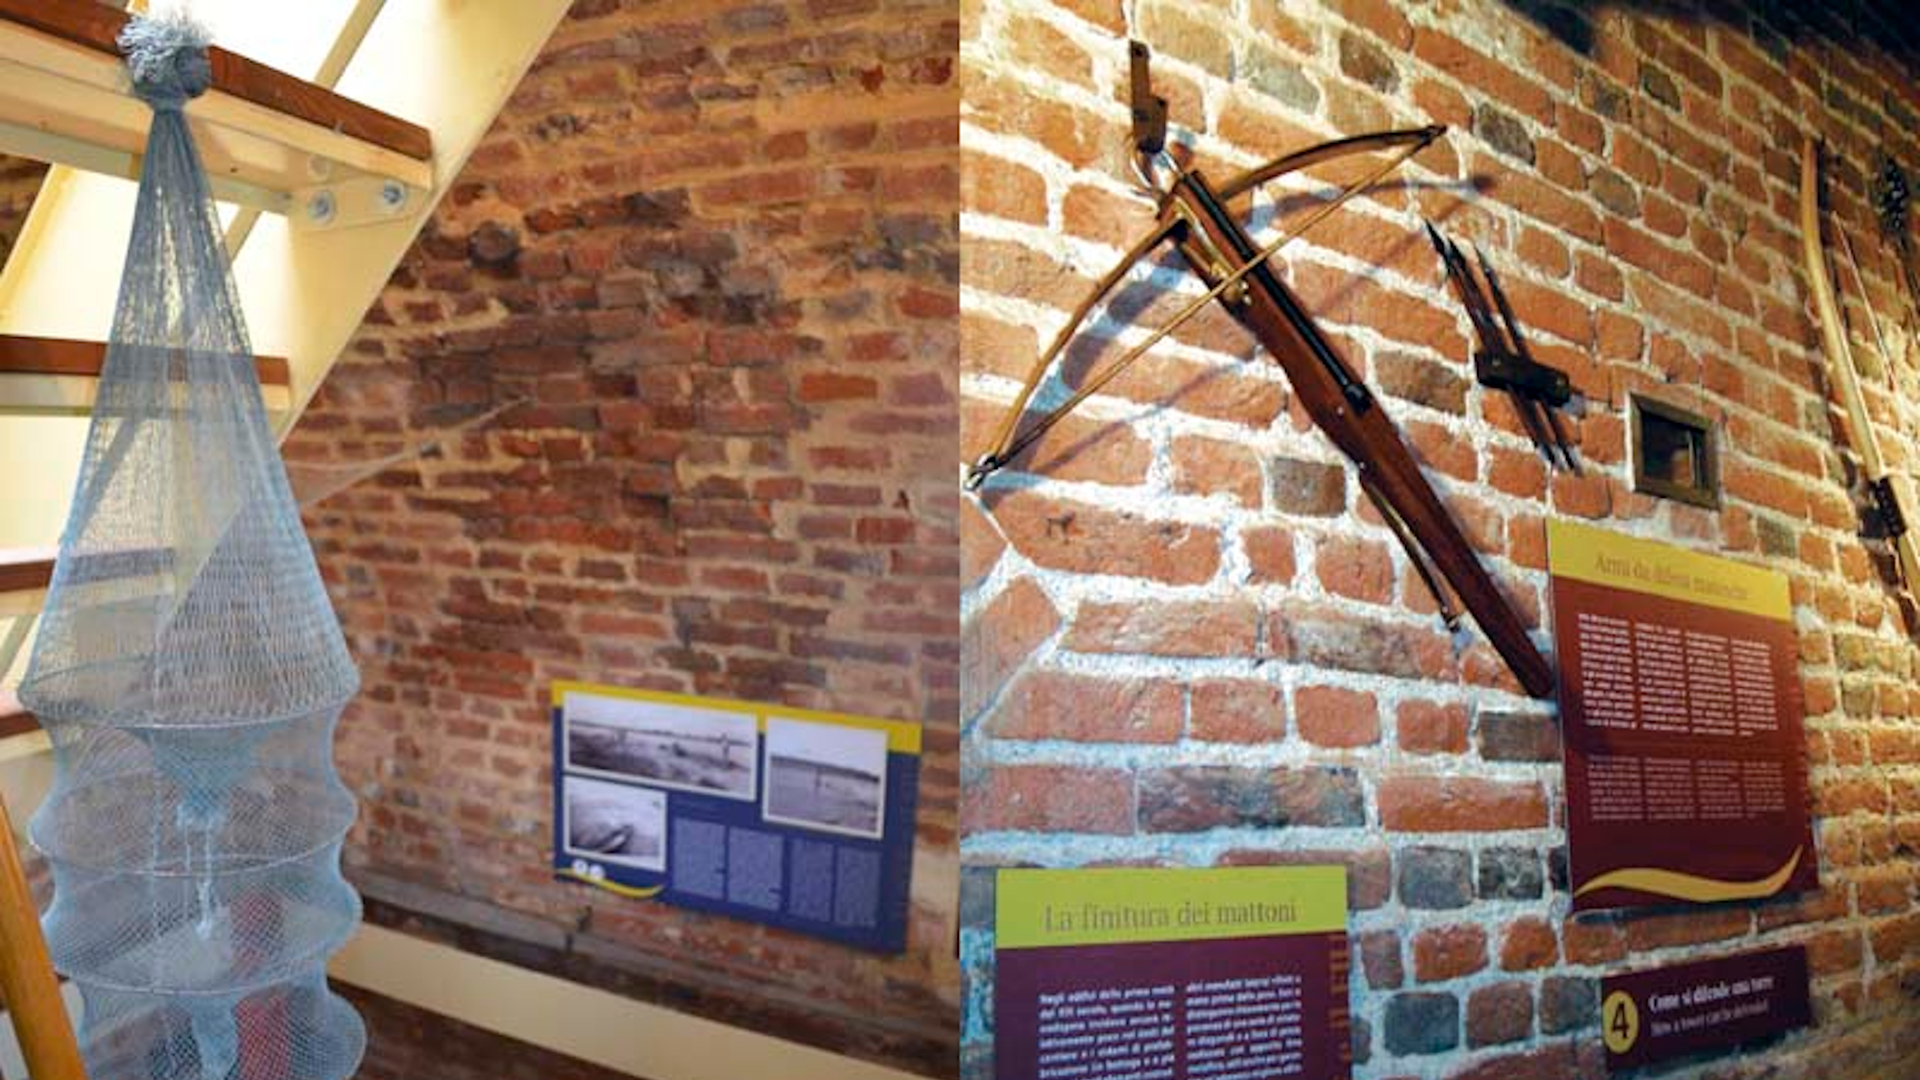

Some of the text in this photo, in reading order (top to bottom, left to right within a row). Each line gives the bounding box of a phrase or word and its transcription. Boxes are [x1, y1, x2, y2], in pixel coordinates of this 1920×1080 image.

[1044, 899, 1298, 932] La finitura dei mattoni
[1648, 994, 1679, 1013] Come
[1681, 986, 1691, 1006] si
[1694, 981, 1729, 1004] difende
[1731, 981, 1750, 996] una
[1612, 1002, 1629, 1038] 4
